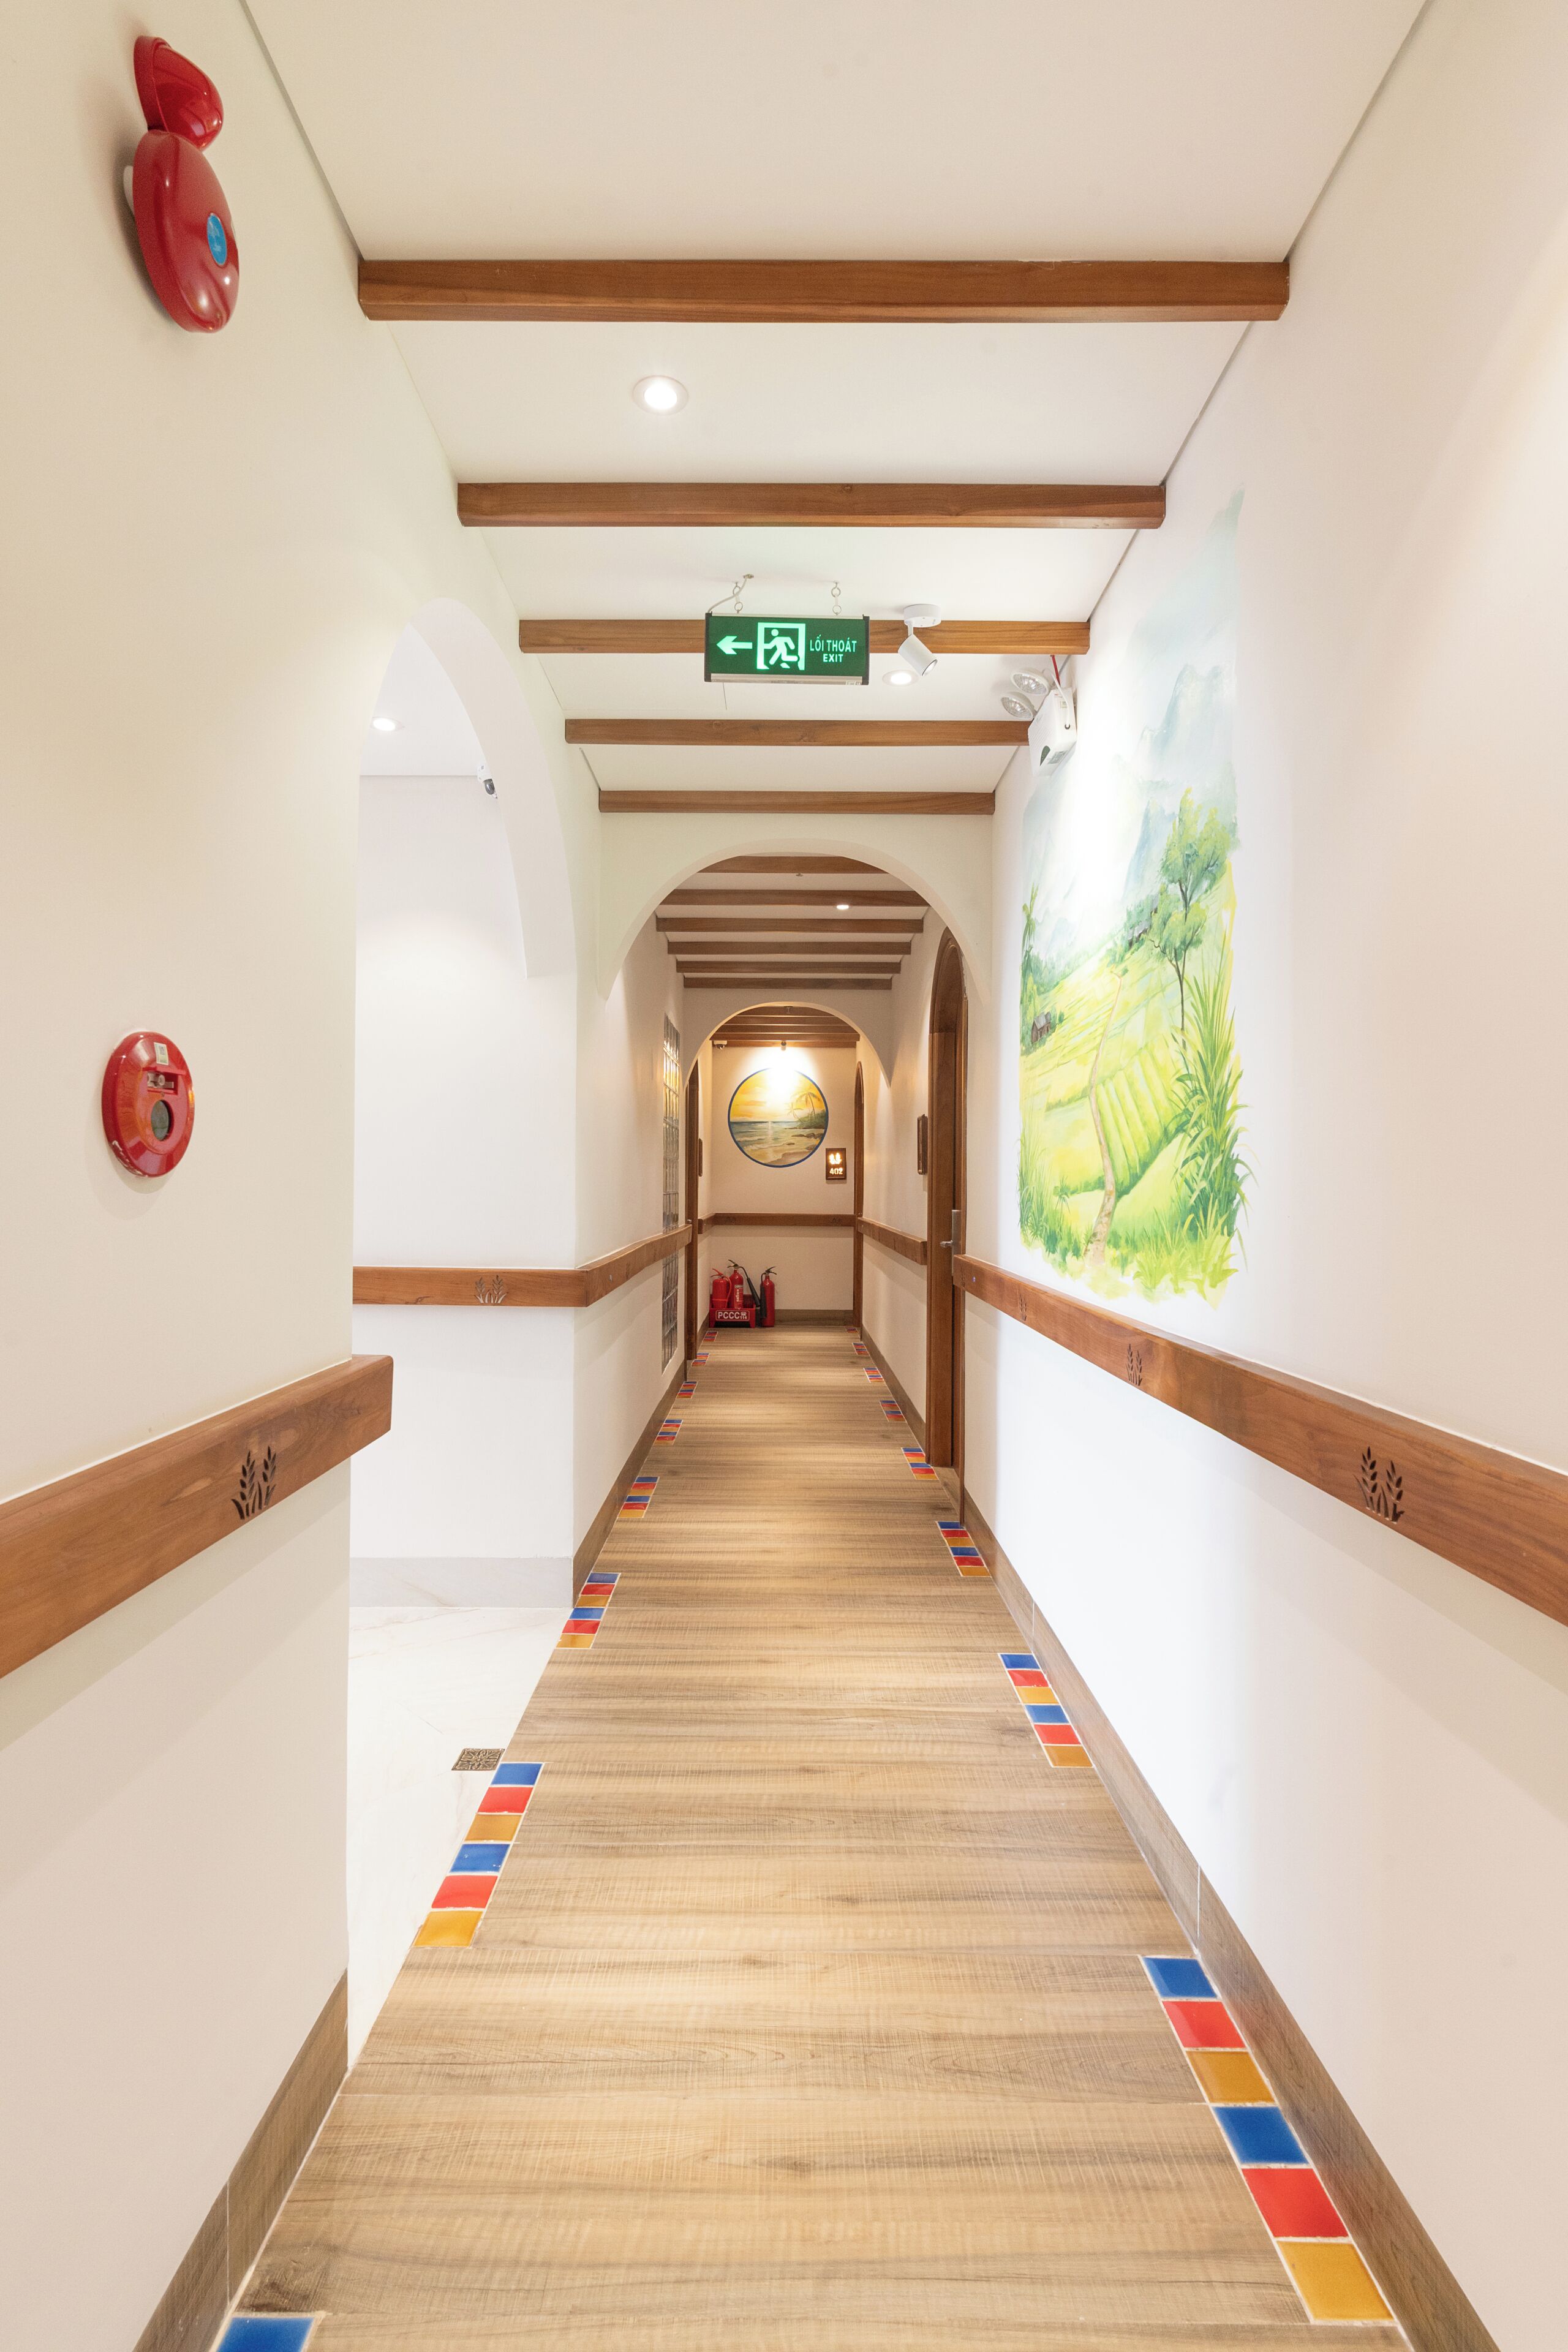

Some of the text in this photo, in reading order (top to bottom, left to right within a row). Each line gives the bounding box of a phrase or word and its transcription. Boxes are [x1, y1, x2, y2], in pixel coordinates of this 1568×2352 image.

[810, 634, 857, 652] LỐI THOÁT
[823, 654, 843, 662] EXIT
